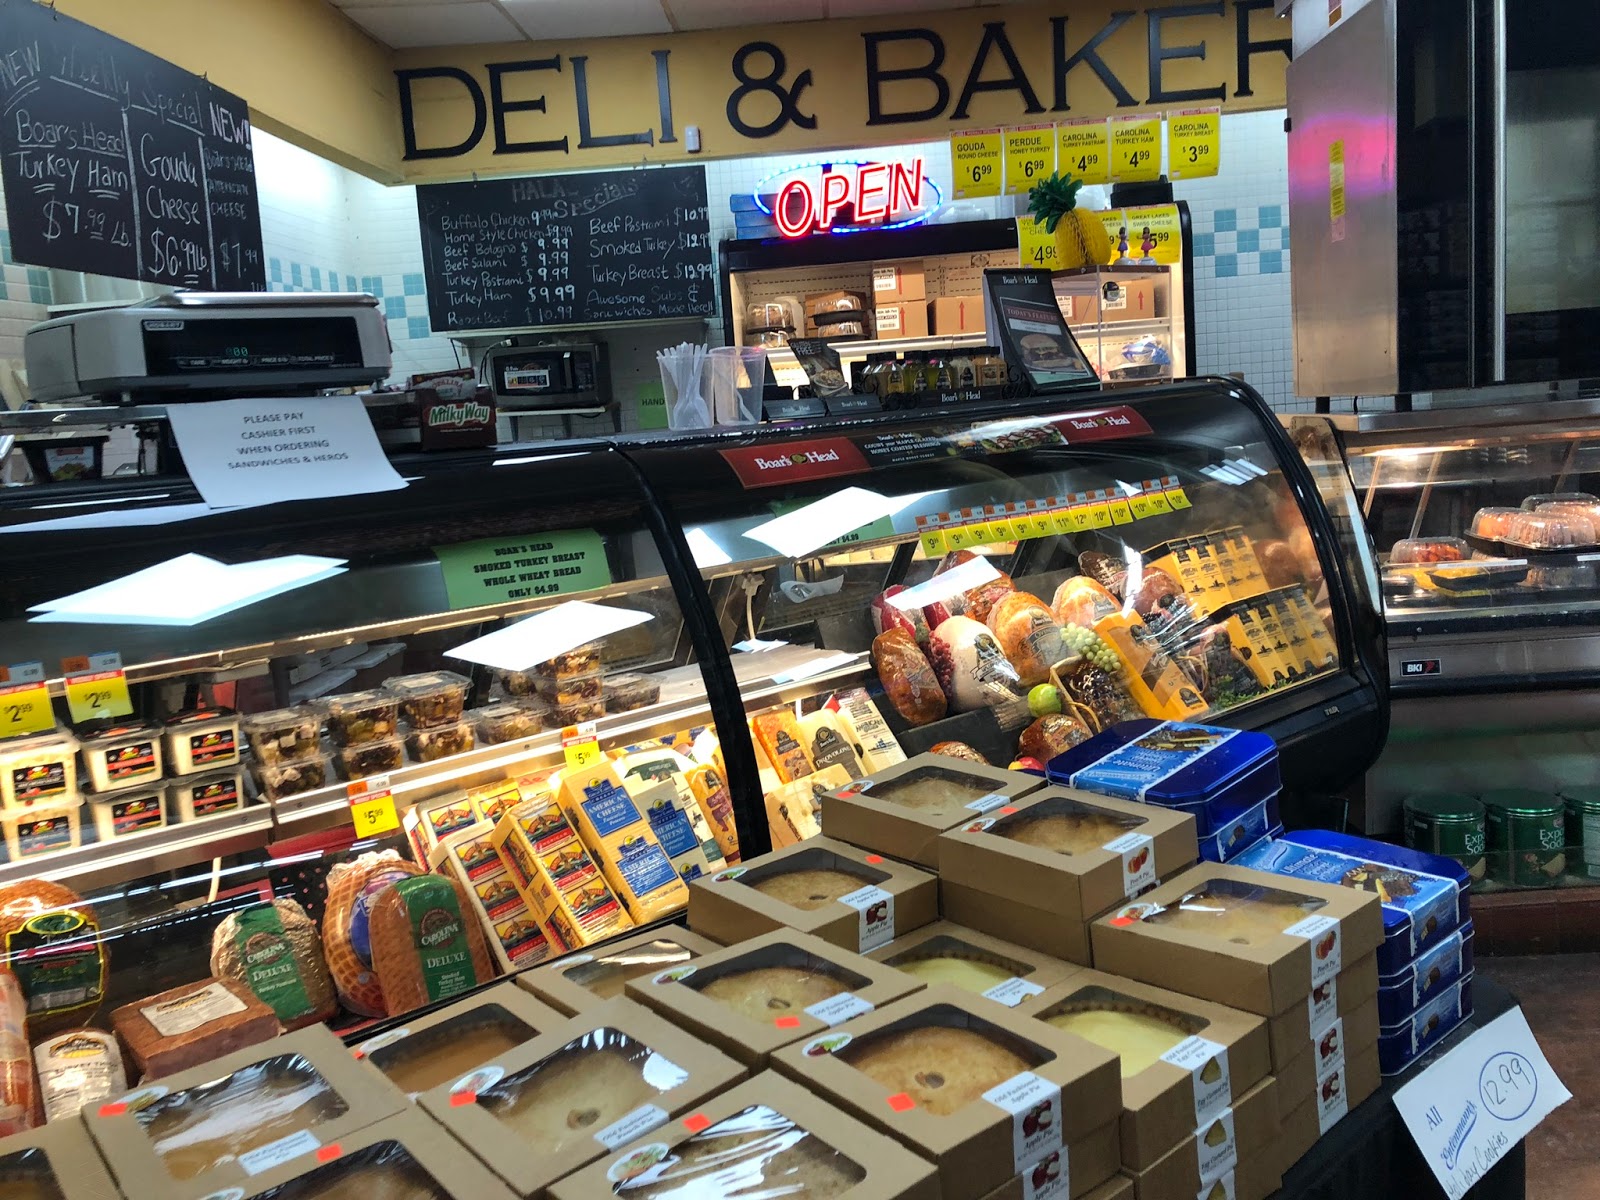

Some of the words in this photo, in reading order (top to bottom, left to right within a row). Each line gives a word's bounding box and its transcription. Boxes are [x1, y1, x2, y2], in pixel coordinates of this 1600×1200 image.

[0, 40, 40, 90] NEW
[394, 50, 678, 161] DELI
[727, 41, 817, 138] &
[16, 109, 77, 149] Boar's
[82, 122, 125, 156] Head
[1115, 128, 1150, 137] CAROLINA
[1173, 122, 1209, 131] CAROLINA
[1009, 137, 1041, 147] PERDUE
[1062, 132, 1097, 141] CAROLINA
[957, 142, 985, 152] GOUDA
[140, 133, 198, 187] Gouda
[9, 151, 78, 193] Turkey
[88, 163, 128, 191] Ham
[146, 186, 200, 225] Cheese
[775, 157, 924, 237] OPEN
[442, 215, 488, 230] Buffalo
[491, 212, 530, 229] Chicken
[590, 215, 621, 235] Beef
[445, 233, 475, 244] Home
[480, 230, 506, 243] Style
[507, 228, 544, 240] Chicken
[444, 245, 469, 257] Beef
[475, 244, 516, 258] Bologna
[590, 238, 641, 258] Smoked
[643, 237, 675, 259] Turkey
[444, 259, 469, 271] Beef
[471, 259, 507, 269] Salami
[442, 272, 477, 290] Turkey
[587, 264, 626, 286] Turkey
[628, 264, 669, 280] Breast
[445, 291, 482, 308] Turkey
[484, 288, 512, 300] Ham
[586, 289, 645, 305] Awesome
[965, 390, 981, 401] Head
[243, 413, 281, 424] PLEASE
[283, 412, 304, 421] PAY
[1071, 420, 1098, 429] Boar's
[1107, 415, 1130, 425] Head
[241, 428, 287, 440] CASHIER
[288, 426, 316, 436] FIRST
[236, 445, 272, 455] WHEN
[274, 440, 330, 452] ORDERING
[227, 457, 300, 470] SANDWICHES
[313, 452, 349, 462] HEROS
[754, 455, 793, 470] Boar's
[805, 449, 840, 463] Head
[495, 545, 527, 556] BOAR'S
[530, 543, 553, 552] HEAD
[473, 561, 511, 573] SMOKED
[514, 556, 549, 568] TURKEY
[552, 552, 585, 563] BREAST
[483, 575, 516, 587] WHOLE
[519, 571, 550, 582] WHEAT
[553, 566, 581, 577] BREAD
[508, 587, 531, 597] ONLY
[535, 584, 559, 594] $4.99
[1407, 663, 1422, 673] BKI
[816, 745, 851, 767] PROVOLONE
[589, 794, 627, 813] AMERICAN
[596, 803, 626, 819] CHEESE
[655, 818, 688, 835] MERICAN
[1467, 843, 1485, 855] Sod
[1280, 853, 1319, 874] Ultimate
[421, 923, 459, 945] CAROLINA
[247, 943, 285, 963] CAROLINA
[427, 952, 466, 969] DELUXE
[252, 964, 293, 981] DELUXE
[1483, 1057, 1531, 1106] 12.99
[1425, 1105, 1443, 1131] All
[1474, 1131, 1509, 1171] Cookies
